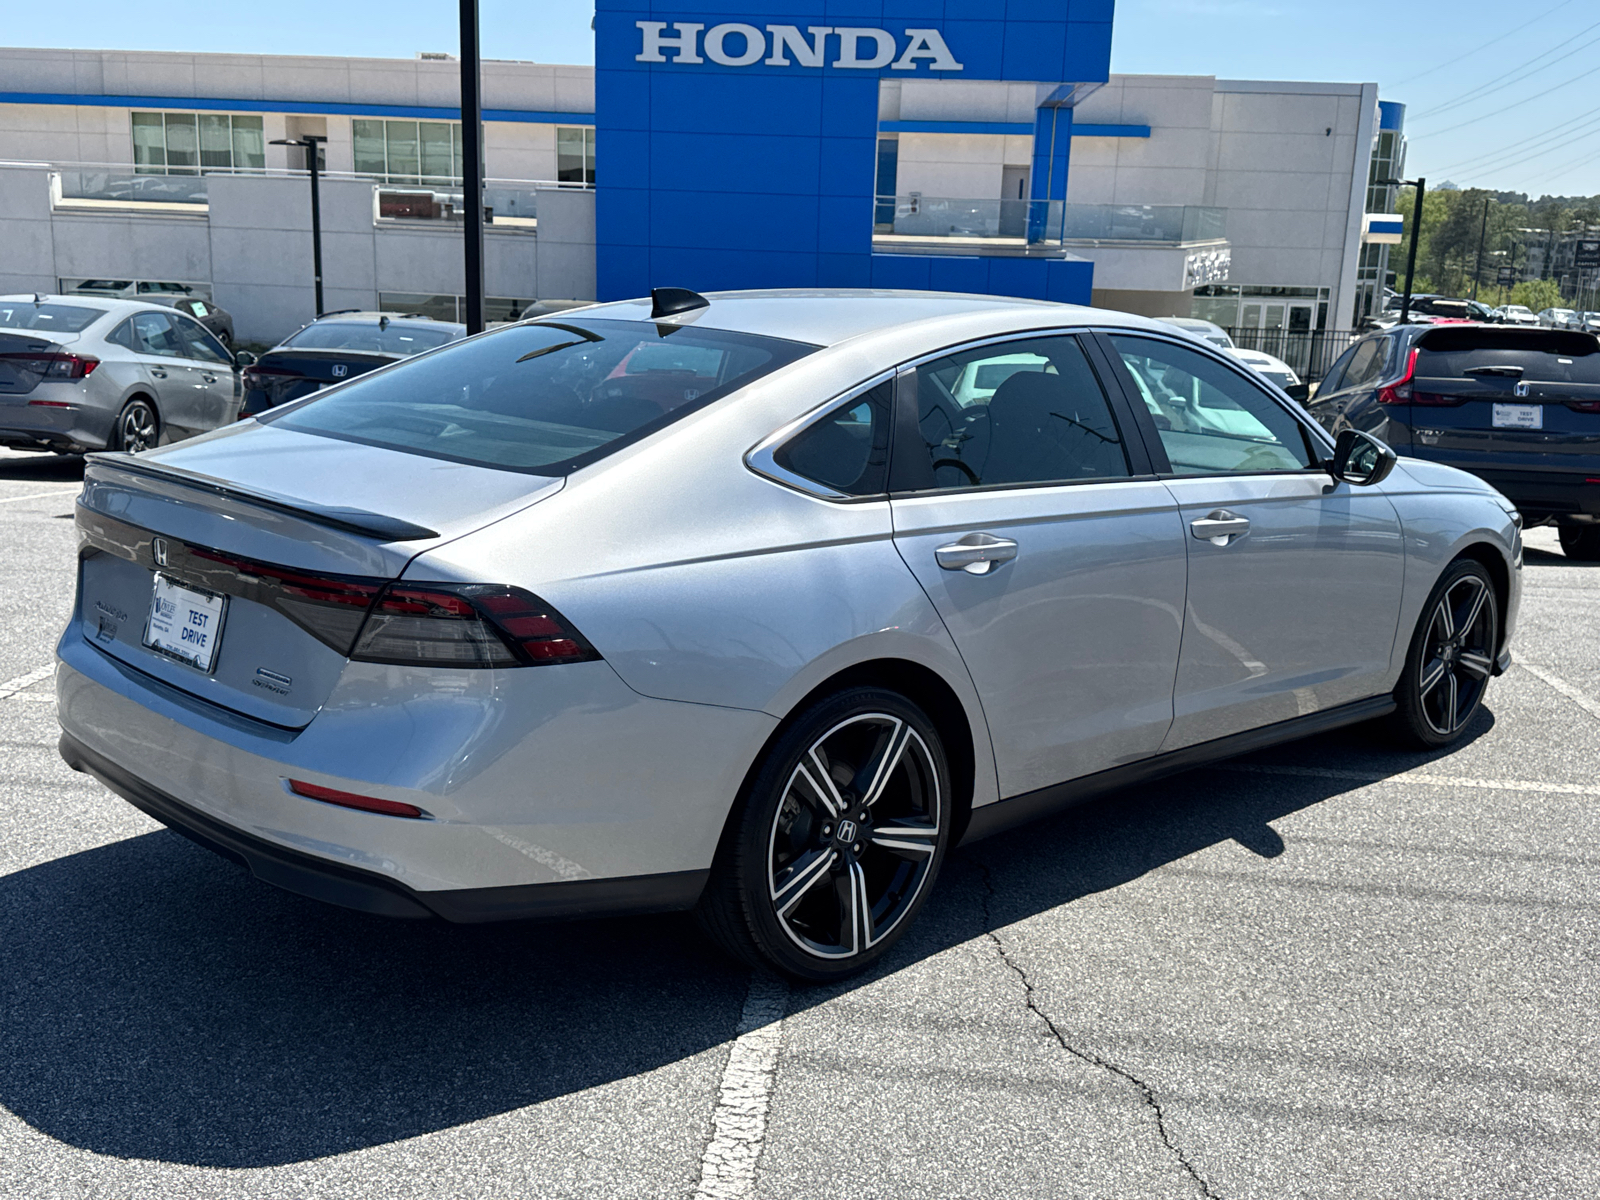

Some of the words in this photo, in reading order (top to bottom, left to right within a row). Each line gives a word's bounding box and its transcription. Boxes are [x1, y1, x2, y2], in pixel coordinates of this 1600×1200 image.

[636, 21, 963, 70] HONDA
[189, 610, 208, 628] TEST
[181, 626, 207, 648] DRIVE
